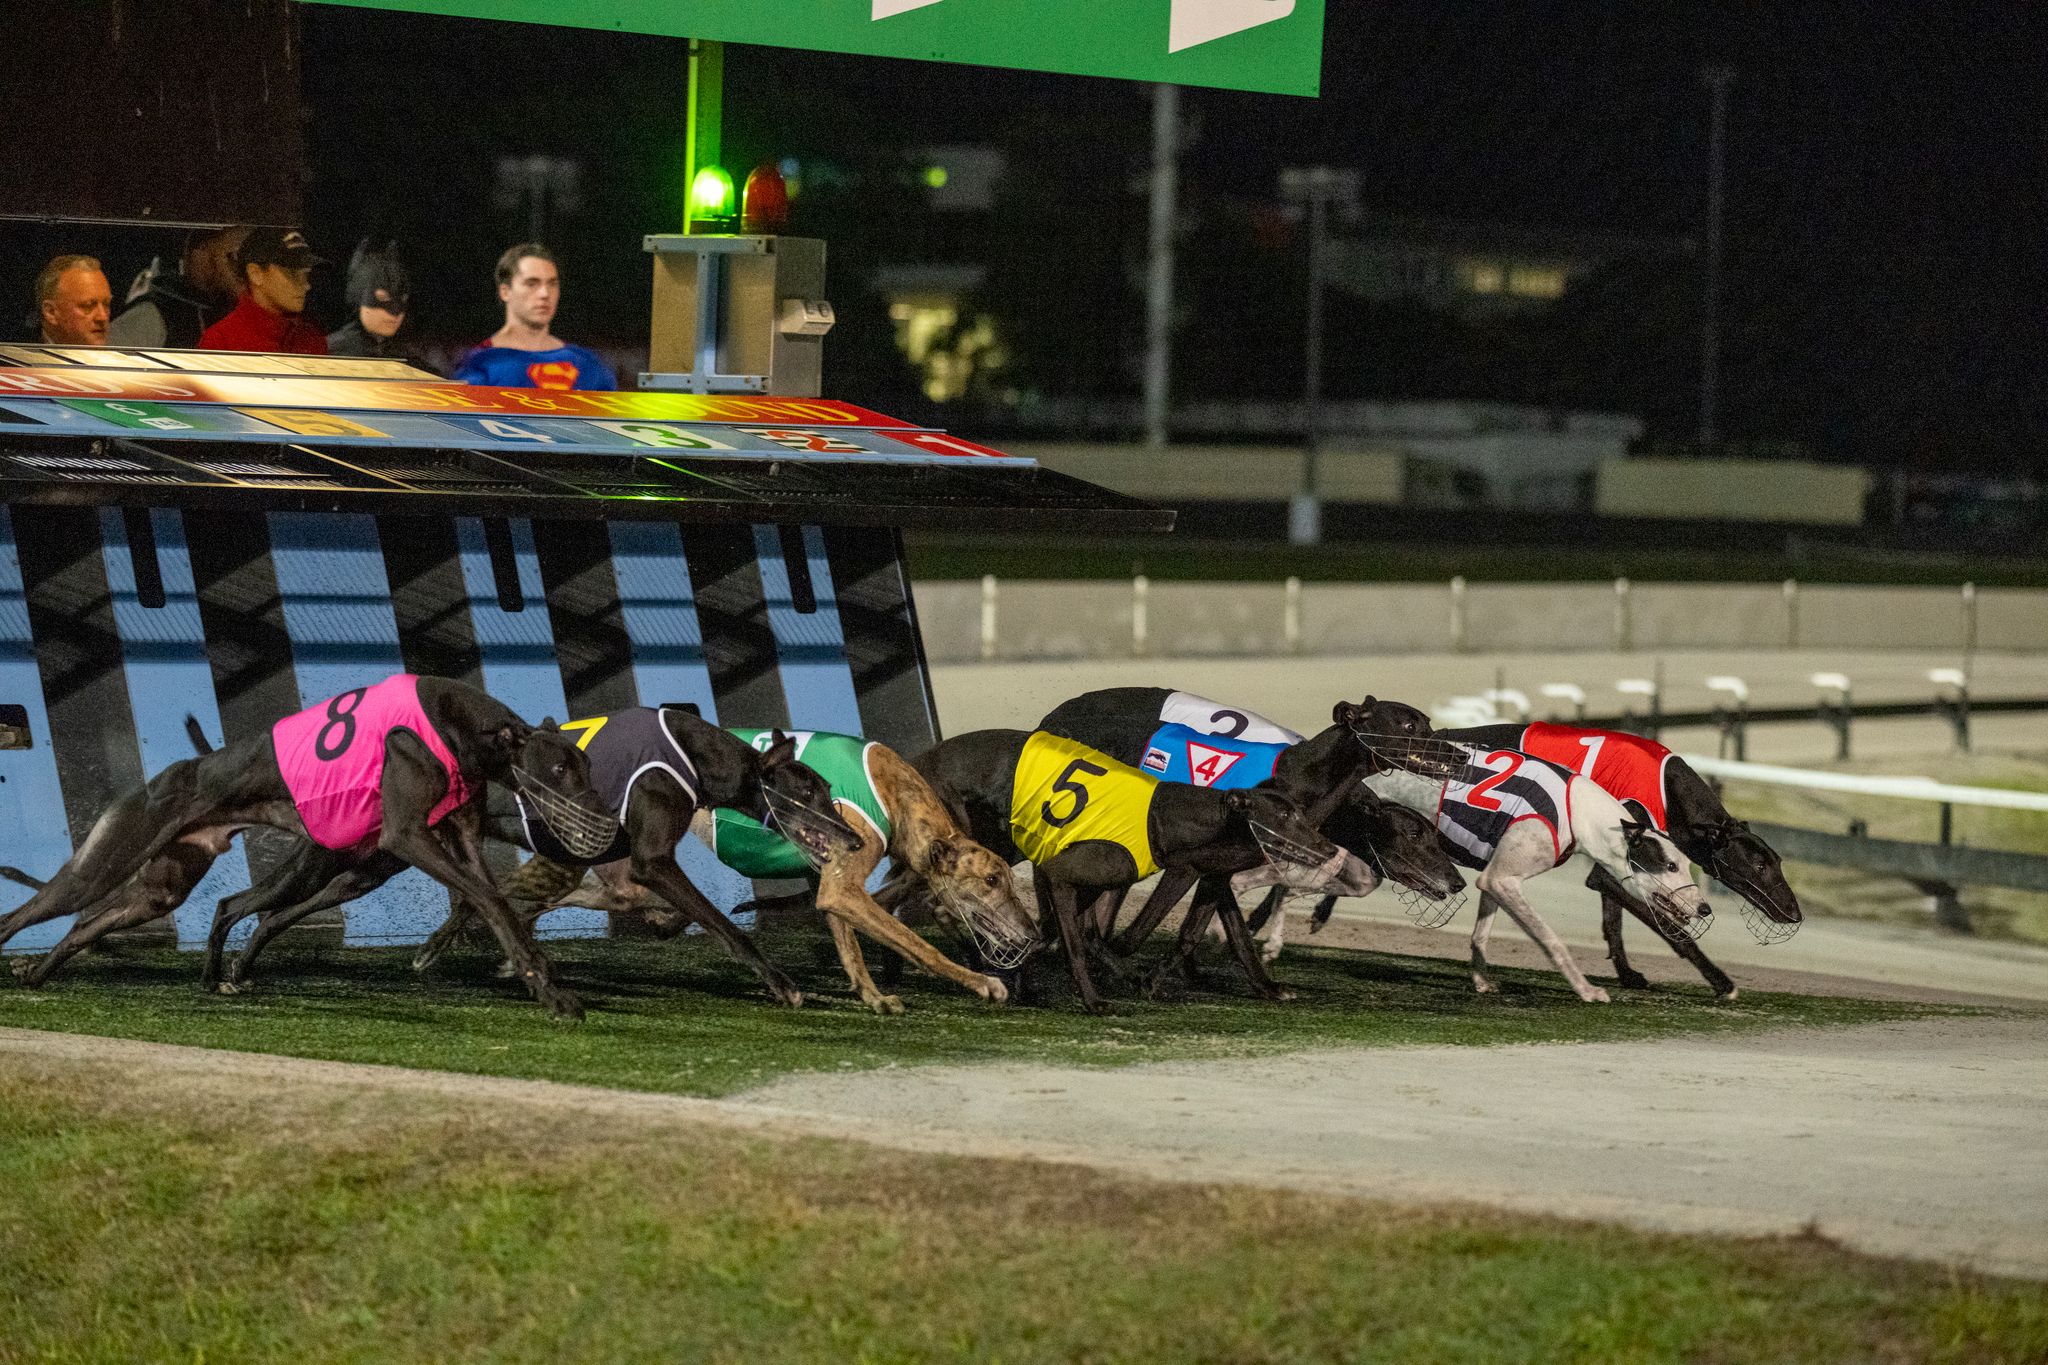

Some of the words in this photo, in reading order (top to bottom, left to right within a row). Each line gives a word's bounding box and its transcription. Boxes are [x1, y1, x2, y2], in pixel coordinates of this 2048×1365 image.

[105, 402, 148, 416] 6
[499, 391, 581, 412] &
[562, 394, 861, 422] HOUND
[265, 411, 363, 436] 5
[479, 419, 557, 443] 4
[621, 425, 713, 449] 3
[766, 430, 863, 453] 2
[914, 434, 992, 457] 1
[315, 688, 367, 761] 8
[1195, 754, 1222, 782] 4
[1579, 736, 1605, 778] 1
[1041, 758, 1108, 829] 5
[1466, 749, 1526, 813] 2
